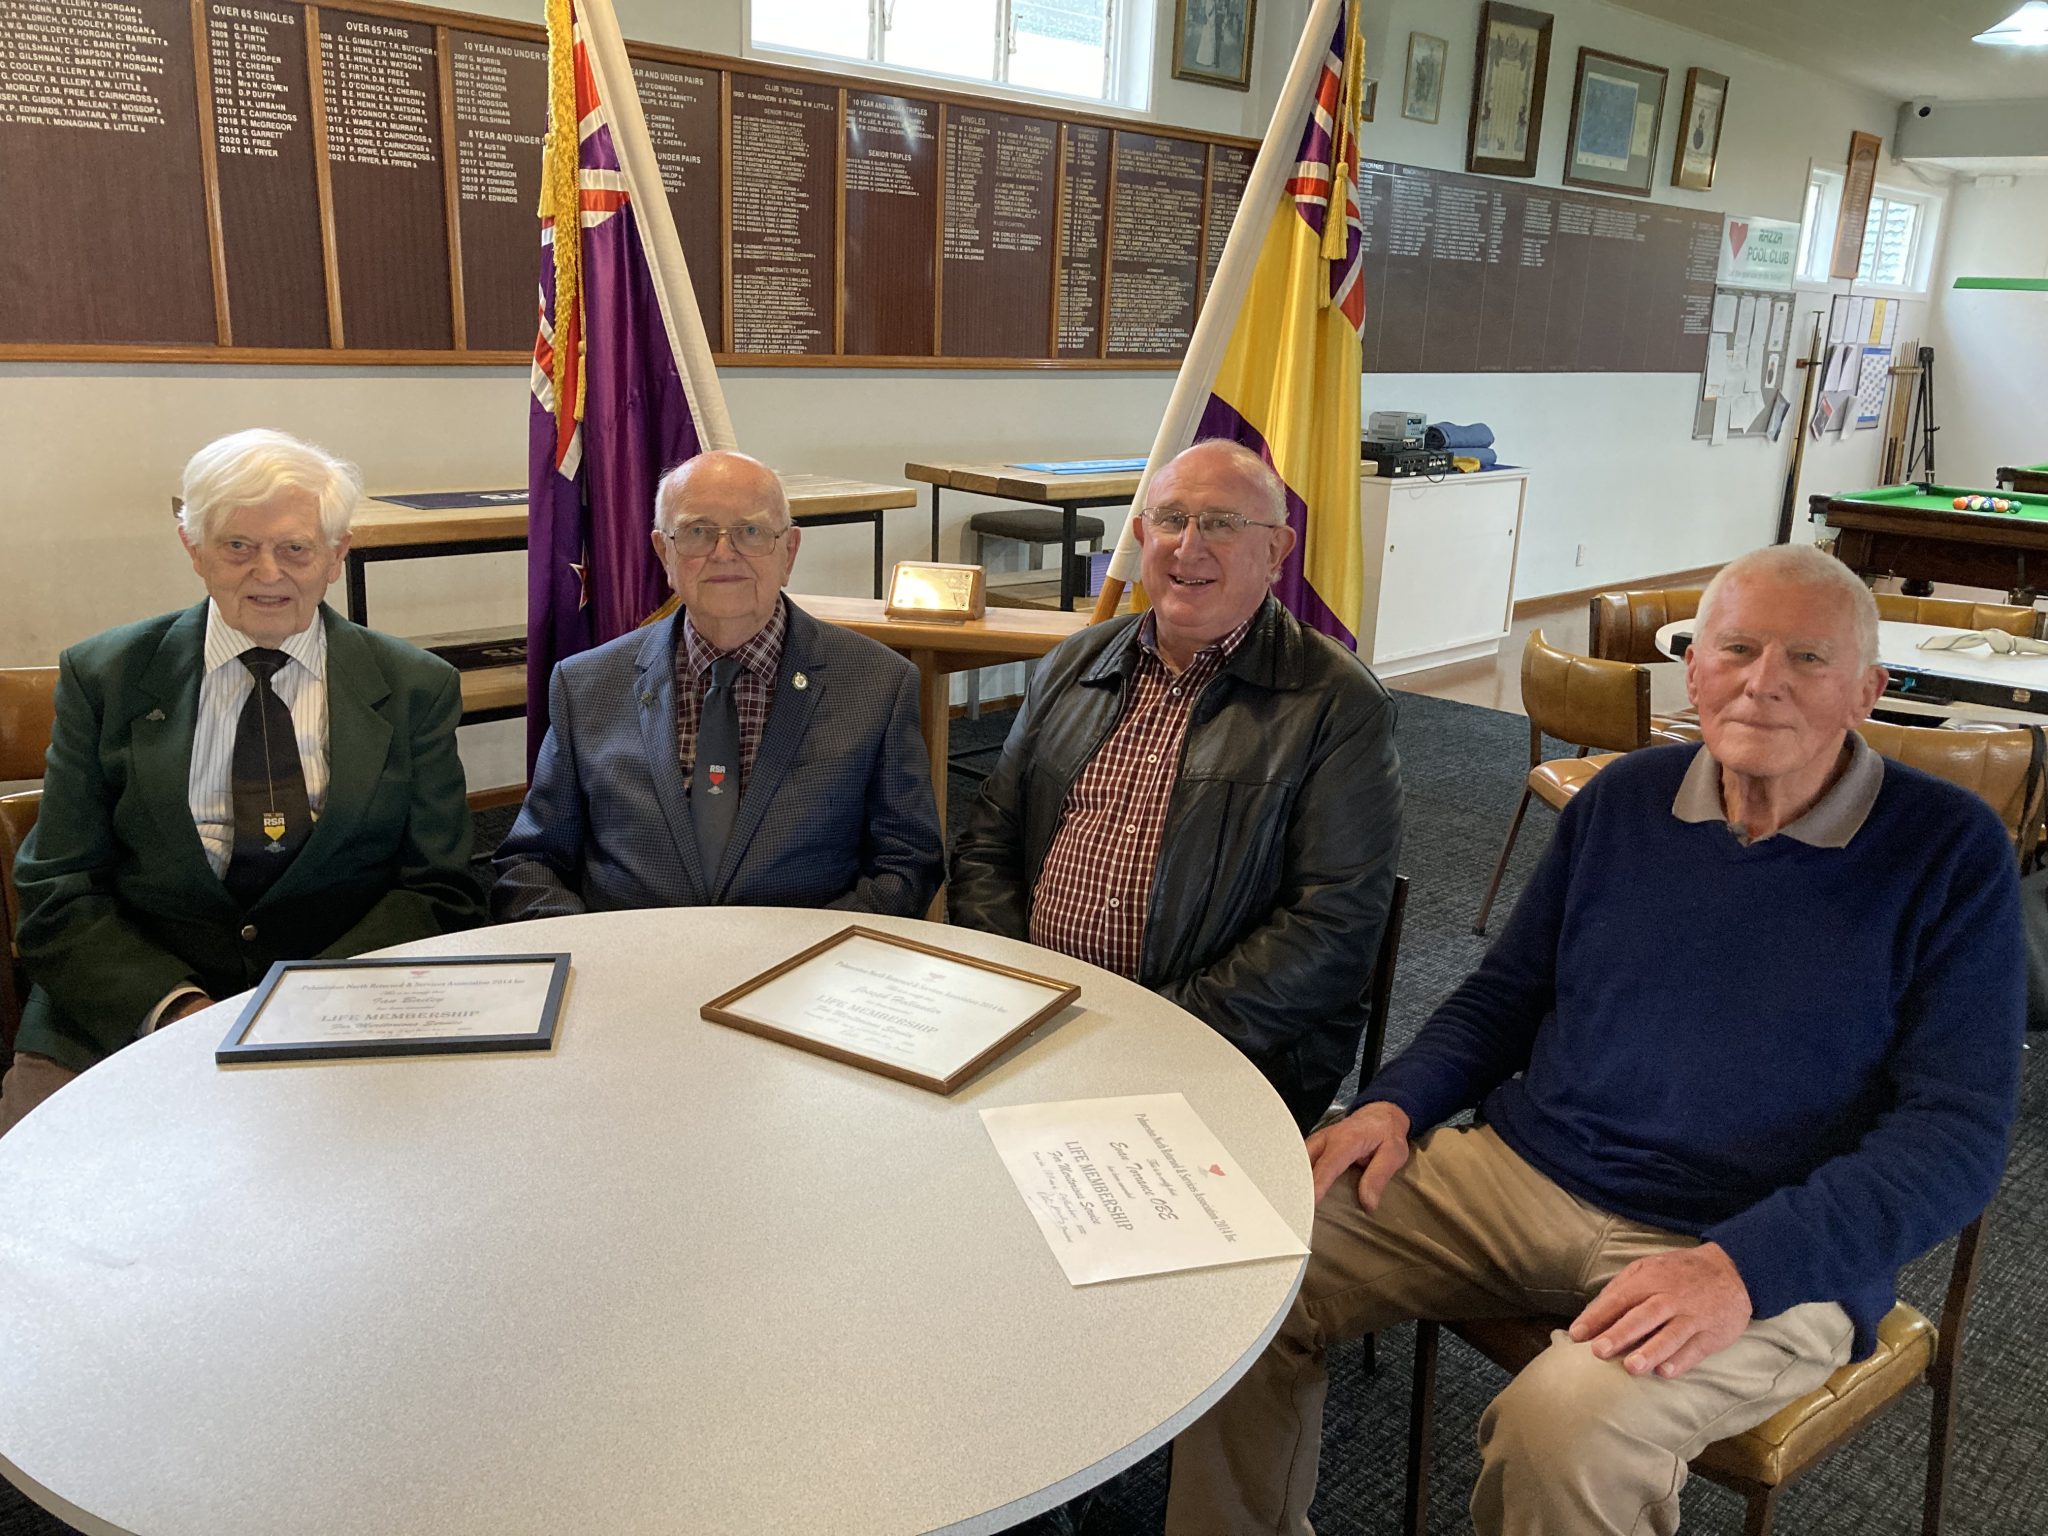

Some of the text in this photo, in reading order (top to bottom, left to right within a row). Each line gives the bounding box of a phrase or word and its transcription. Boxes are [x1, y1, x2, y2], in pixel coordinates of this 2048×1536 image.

[212, 4, 294, 24] OVER 65 SINGLES
[115, 23, 149, 33] HORGAN
[346, 21, 408, 39] OVER 65 PAIRS
[126, 34, 162, 44] BARRETT
[464, 42, 473, 50] 10
[474, 43, 495, 53] YEAR
[496, 46, 513, 56] AND
[514, 49, 540, 60] UNDER
[250, 53, 281, 63] HOOPER
[245, 62, 274, 72] CHERRI
[246, 71, 275, 81] STOKES
[645, 70, 659, 79] AND
[660, 73, 683, 83] UNDER
[684, 76, 704, 86] PAIRS
[476, 82, 507, 92] HODGSON
[765, 84, 803, 96] CLUB TRIPLES
[99, 91, 152, 103] CAIRNCROSS
[252, 90, 275, 100] DUFFY
[122, 104, 155, 112] MOSSOP
[255, 101, 286, 111] URBAHN
[813, 103, 830, 111] LITTLE
[860, 99, 874, 107] YEAR
[874, 101, 886, 109] AND
[906, 107, 928, 116] TRIPLES
[216, 106, 237, 115] 2017
[249, 110, 297, 122] CAIRNCROSS
[764, 108, 802, 119] SENIOR TRIPLES
[217, 116, 238, 125] 2018
[250, 120, 292, 131] McGREGOR
[961, 115, 986, 126] SINGLES
[218, 126, 239, 135] 2019
[251, 129, 283, 139] GARRETT
[474, 130, 495, 140] YEAR
[496, 133, 513, 142] AND
[514, 135, 540, 145] UNDER
[219, 136, 240, 144] 2020
[252, 139, 271, 147] FREE
[220, 145, 278, 157] 2021 M. FRYER
[868, 149, 911, 161] SENIOR TRIPLES
[391, 159, 412, 167] FRYER
[658, 152, 701, 164] UNDER PAIRS
[486, 160, 514, 169] KENNEDY
[462, 184, 478, 192] 2020
[488, 186, 518, 195] EDWARDS
[488, 194, 518, 203] EDWARDS
[1758, 229, 1783, 244] RAZZA
[1746, 246, 1789, 265] POOL CLUB
[710, 765, 726, 773] RSA
[264, 817, 285, 826] RSA
[365, 1011, 480, 1020] MEMBERSHIP
[816, 995, 848, 1008] LIFE
[847, 1004, 939, 1033] MEMBERSHIP
[1064, 1141, 1134, 1230] LIFE MEMBERSHIP
[1213, 1220, 1231, 1234] 2014
